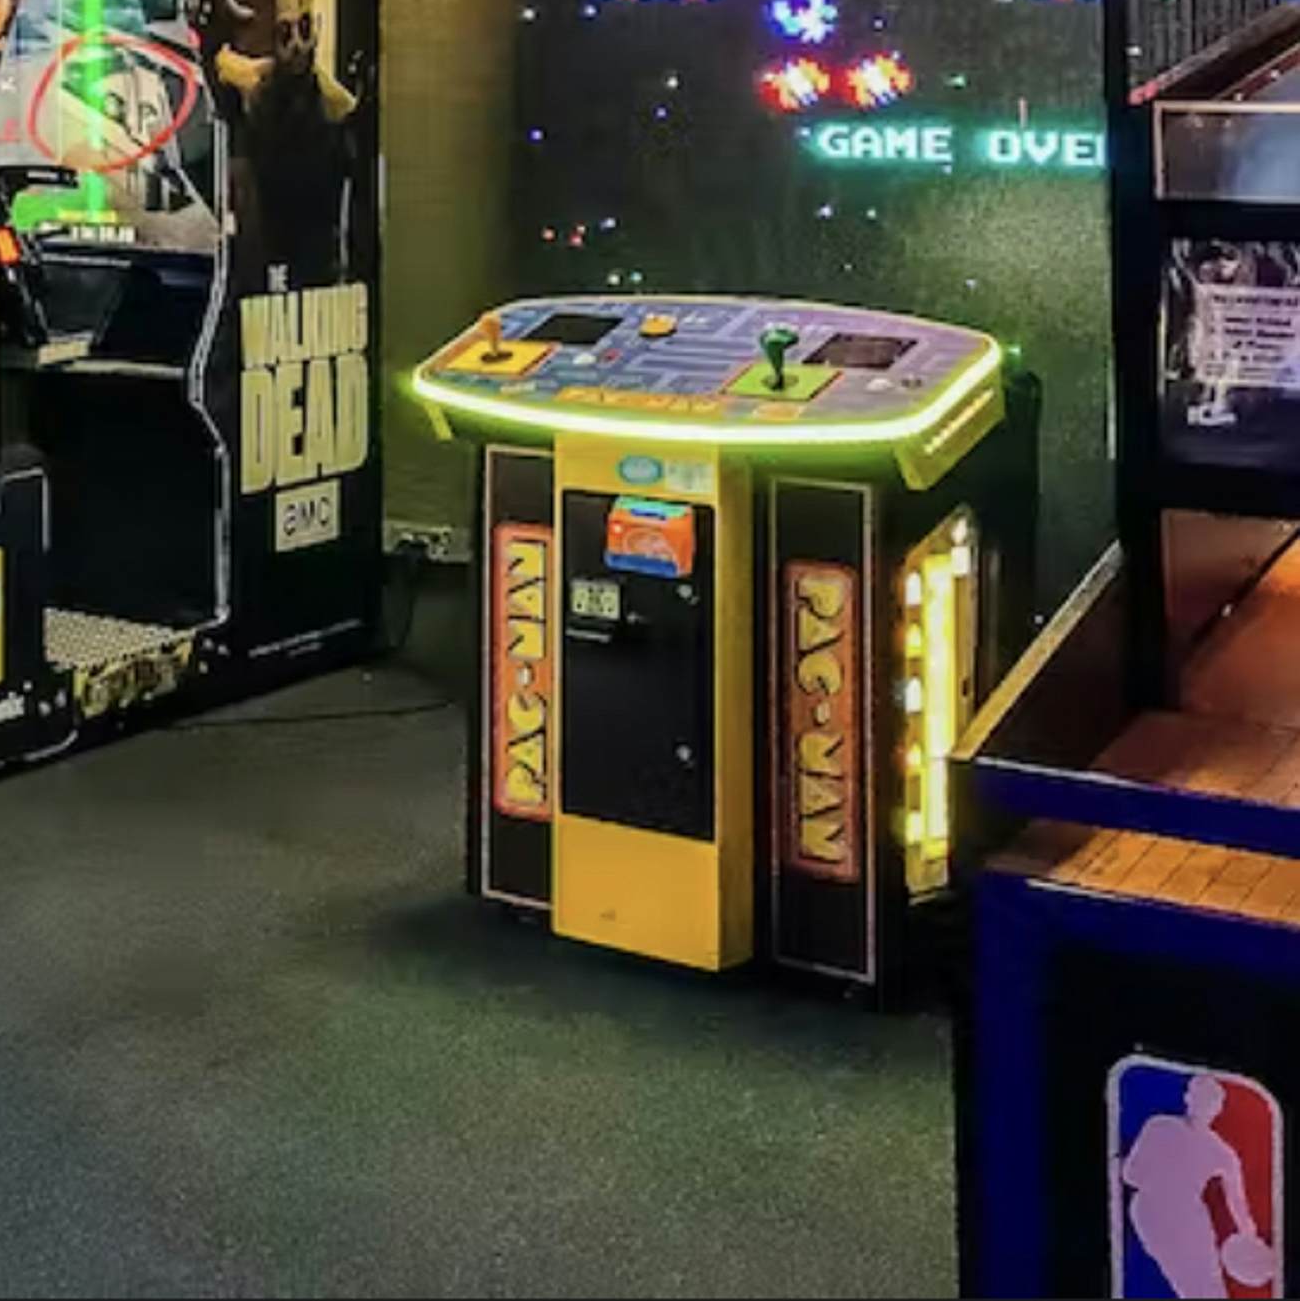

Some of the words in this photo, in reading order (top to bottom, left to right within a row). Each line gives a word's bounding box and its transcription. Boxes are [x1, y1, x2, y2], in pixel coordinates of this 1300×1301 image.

[819, 125, 952, 162] GAME
[988, 129, 1105, 167] OVE
[240, 282, 368, 372] WALKING
[240, 353, 368, 495] DEAD
[507, 540, 546, 808] PAC-MAN
[798, 574, 844, 862] PAC-MAN
